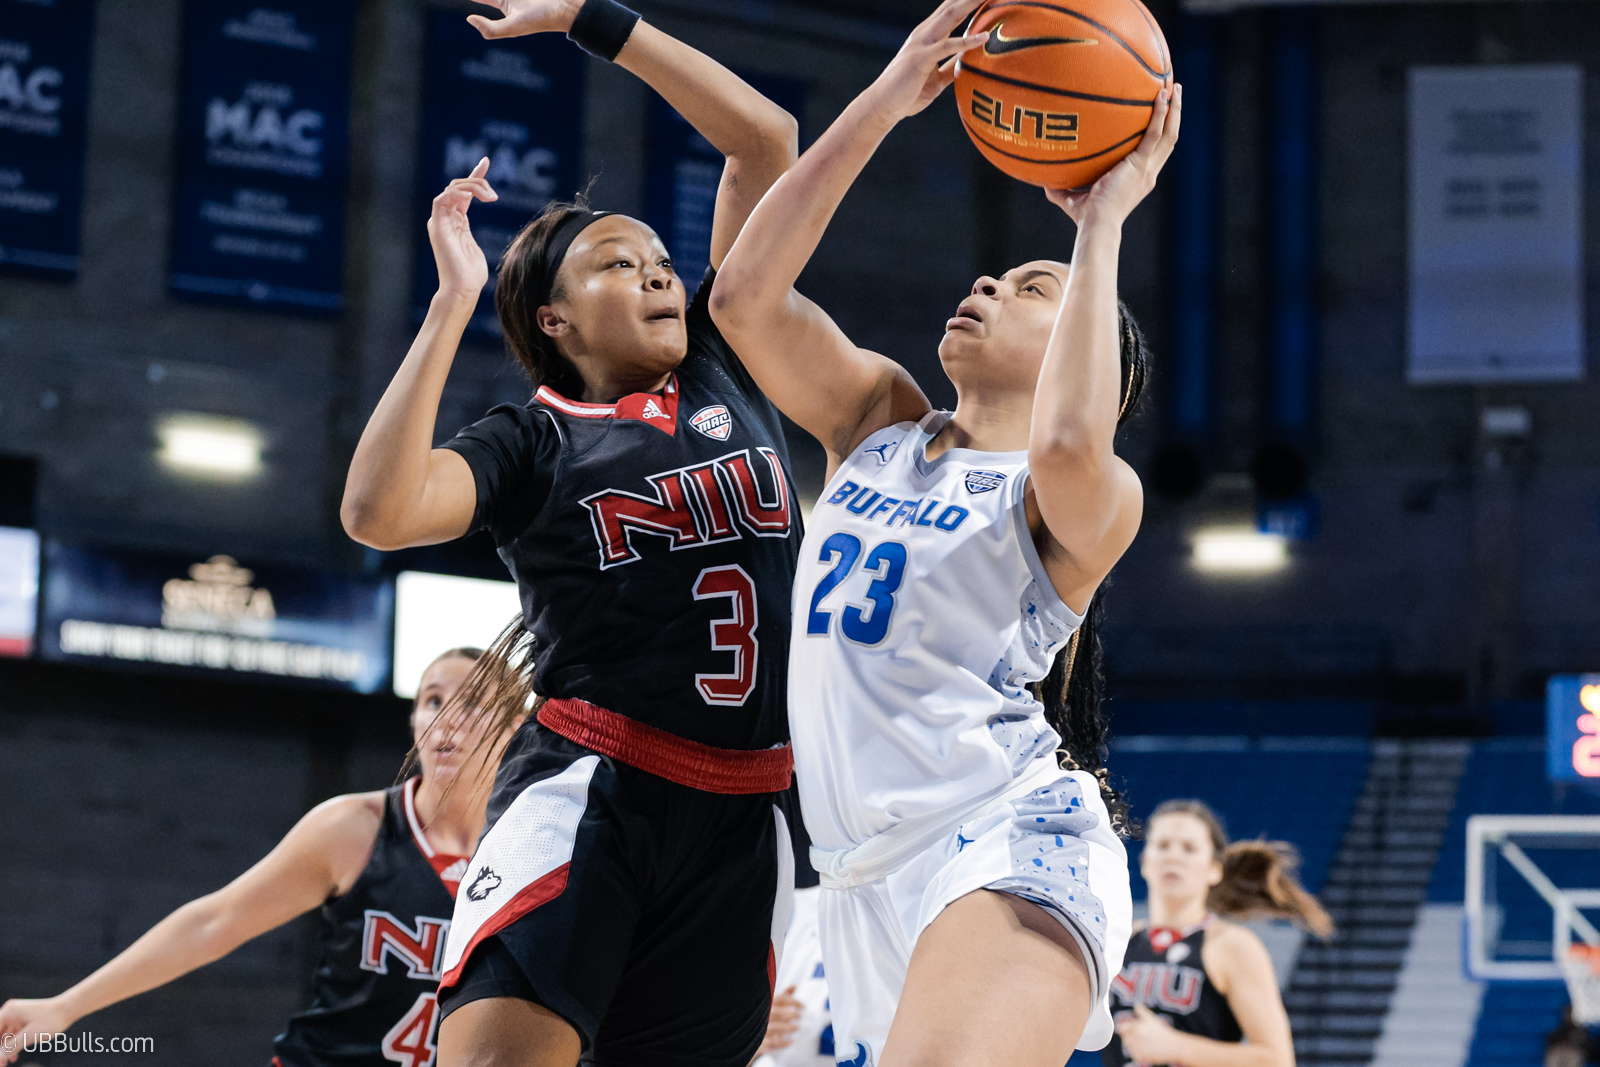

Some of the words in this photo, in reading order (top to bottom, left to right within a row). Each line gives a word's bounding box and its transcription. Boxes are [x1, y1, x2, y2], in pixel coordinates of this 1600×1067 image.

[0, 64, 62, 114] AC
[972, 88, 1079, 142] ELITE
[204, 97, 323, 157] MAC
[444, 136, 557, 195] MAC
[698, 413, 728, 432] MAC
[578, 447, 791, 571] NIU
[824, 479, 971, 533] BUFFALO
[806, 530, 910, 648] 23
[691, 563, 759, 707] 3
[360, 909, 452, 982] N
